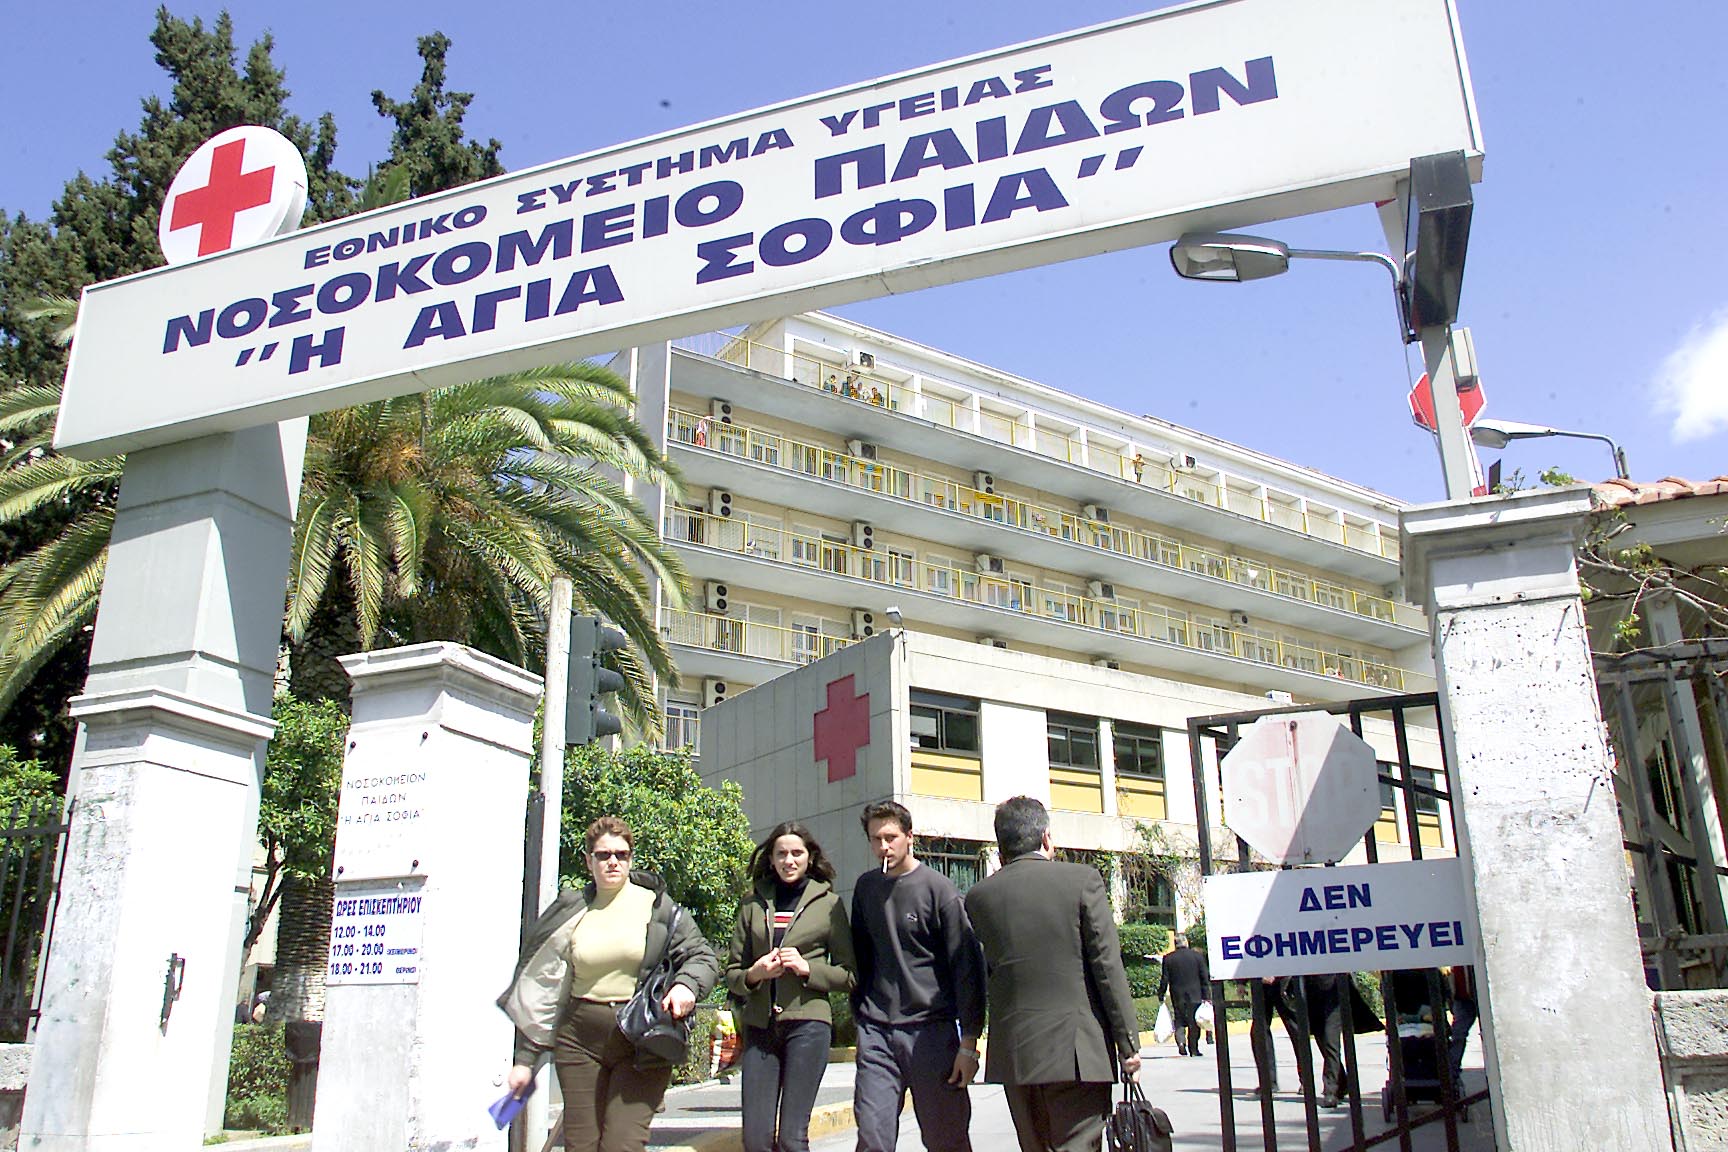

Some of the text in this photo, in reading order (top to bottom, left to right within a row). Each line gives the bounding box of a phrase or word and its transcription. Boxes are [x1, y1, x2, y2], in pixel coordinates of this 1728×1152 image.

[304, 64, 1054, 270] ΕΘΝΙΚΟ ΣΥΣΤΗΜΑ ΥΓΕΙΑΣ
[163, 56, 1279, 355] ΝΟΣΟΚΟΜΕΙΟ ΠΑΙΔΩΝ
[403, 264, 625, 350] ΑΓΙΑ
[346, 772, 426, 790] ΝΟΣΟΚΟΜΕΙΟΝ
[361, 792, 407, 806] ΠΑΙΔΩΝ
[355, 813, 380, 825] ΑΓΙΑ
[336, 896, 422, 917] ΩΡΕΣ ΕΠΙΣΚΕΠΤΗΡΙΟΥ
[1299, 883, 1373, 913] ΔΕΝ
[334, 925, 356, 939] 12.00
[363, 924, 386, 938] 14.00
[1221, 921, 1465, 961] ΕΦΗΜΕΡΕΥΕΙ
[332, 944, 354, 957] 17.00
[361, 942, 384, 956] 20.00
[330, 962, 353, 975] 18.00
[360, 961, 383, 974] 21.00
